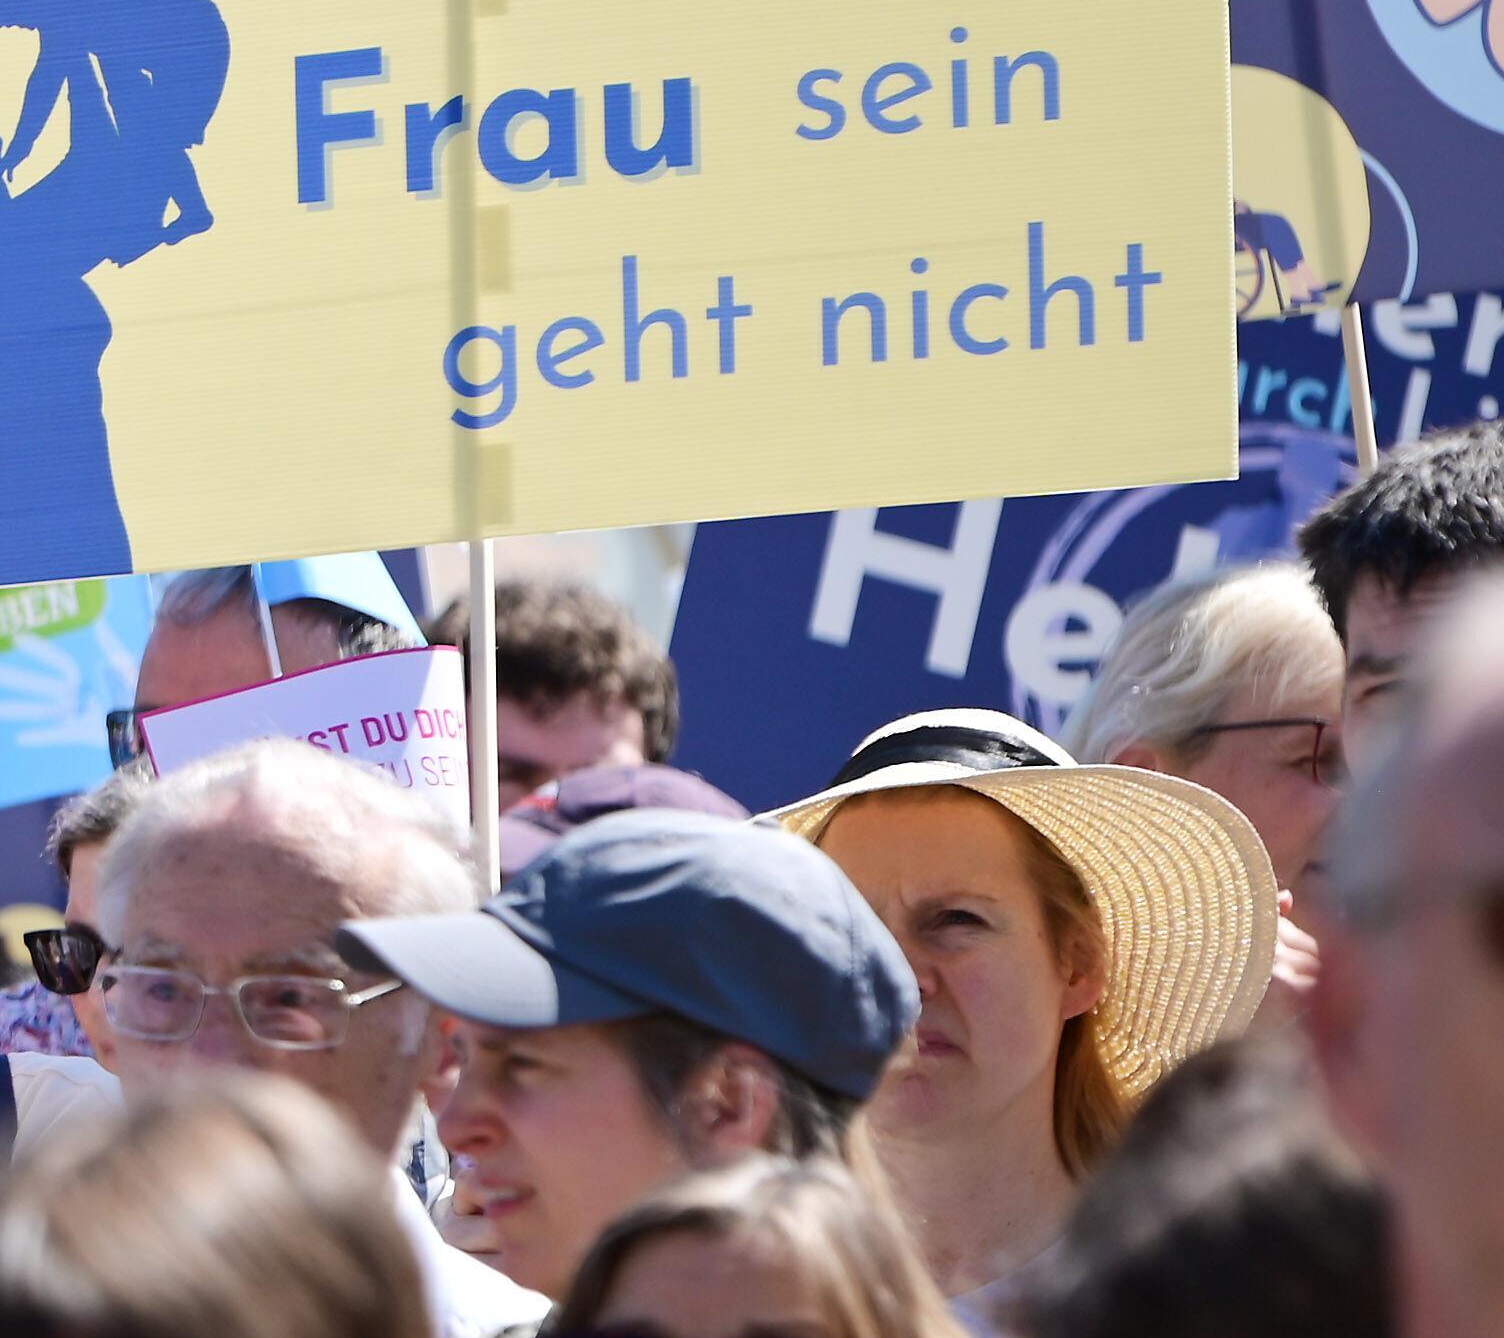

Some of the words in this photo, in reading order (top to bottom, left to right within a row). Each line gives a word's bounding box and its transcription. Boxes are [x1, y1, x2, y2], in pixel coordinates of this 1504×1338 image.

[294, 44, 702, 210] Frau
[793, 27, 1064, 142] sein
[442, 255, 753, 430] geht
[819, 221, 1164, 367] nicht
[360, 711, 409, 748] DU
